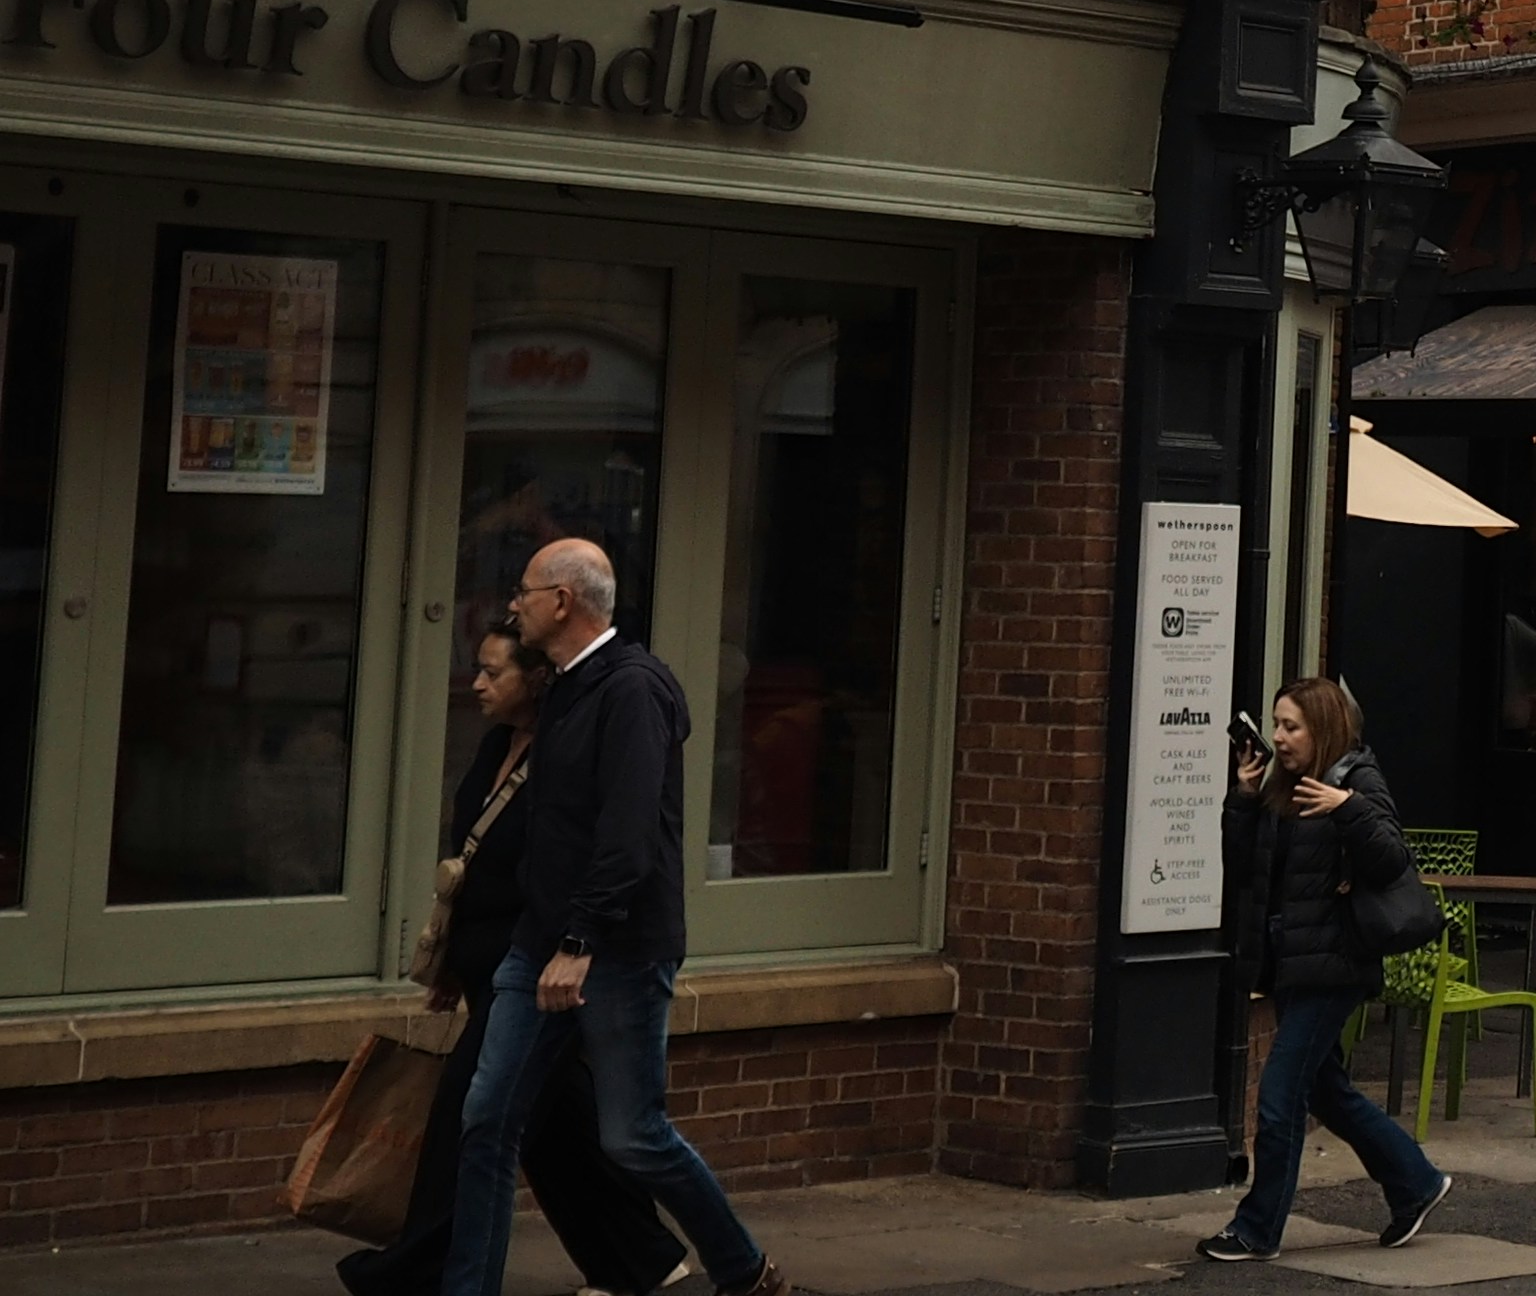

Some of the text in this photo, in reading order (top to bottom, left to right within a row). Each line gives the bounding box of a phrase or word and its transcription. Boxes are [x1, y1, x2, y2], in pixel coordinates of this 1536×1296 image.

[191, 260, 328, 290] CLASS ACT
[1157, 519, 1234, 532] wetherspoon
[1171, 540, 1217, 550] OPEN FOR
[1168, 553, 1218, 563] BREAKFAST
[1161, 574, 1223, 585] FOOD SERVED
[1174, 587, 1210, 597] ALL DAY
[1163, 675, 1212, 685] UNLIMITED
[1164, 688, 1209, 697] FREE Wi-Fi
[1159, 707, 1211, 725] LAVAZZA
[1160, 749, 1207, 759] CASK ALES
[1172, 762, 1193, 771] AND
[1153, 774, 1212, 785] CRAFT BEERS
[1166, 809, 1195, 819] WINES
[1170, 822, 1190, 832] AND
[1163, 835, 1195, 845] SPIRITS
[1170, 871, 1200, 880] ACCESS
[1141, 895, 1211, 906] ASSISTANCE DOGS
[1165, 907, 1186, 916] ONLY
